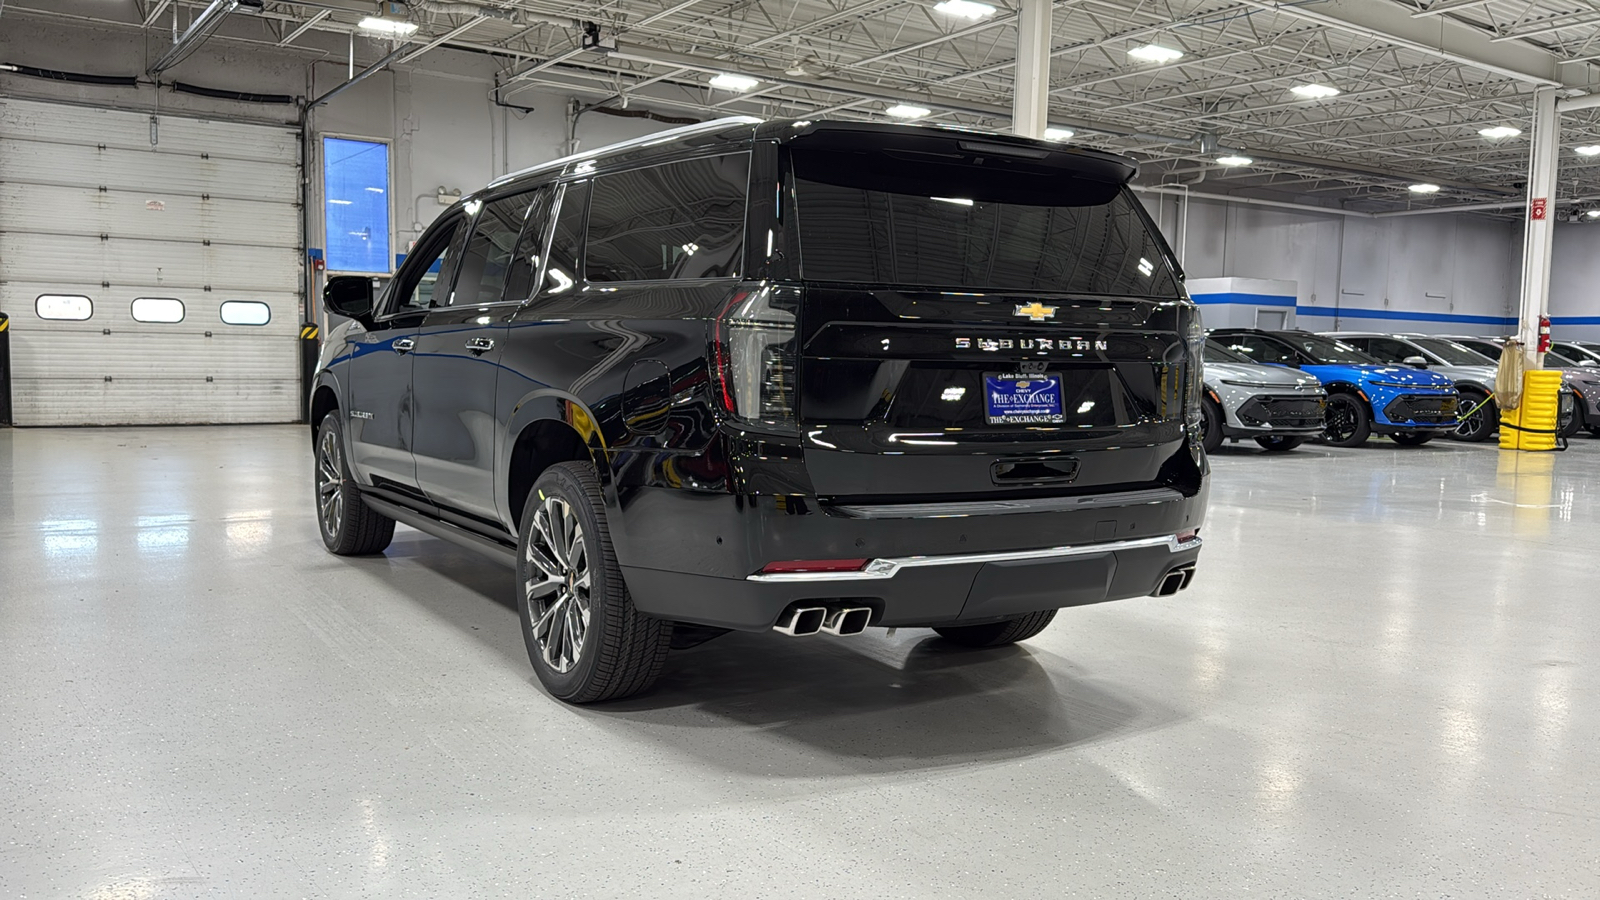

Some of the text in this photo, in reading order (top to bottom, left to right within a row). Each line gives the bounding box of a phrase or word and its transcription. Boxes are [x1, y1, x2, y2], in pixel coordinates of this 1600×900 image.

[955, 338, 1108, 350] SUBURBAN
[993, 394, 1055, 403] THE EXCHANGE
[1010, 415, 1049, 423] EXCHANGE
